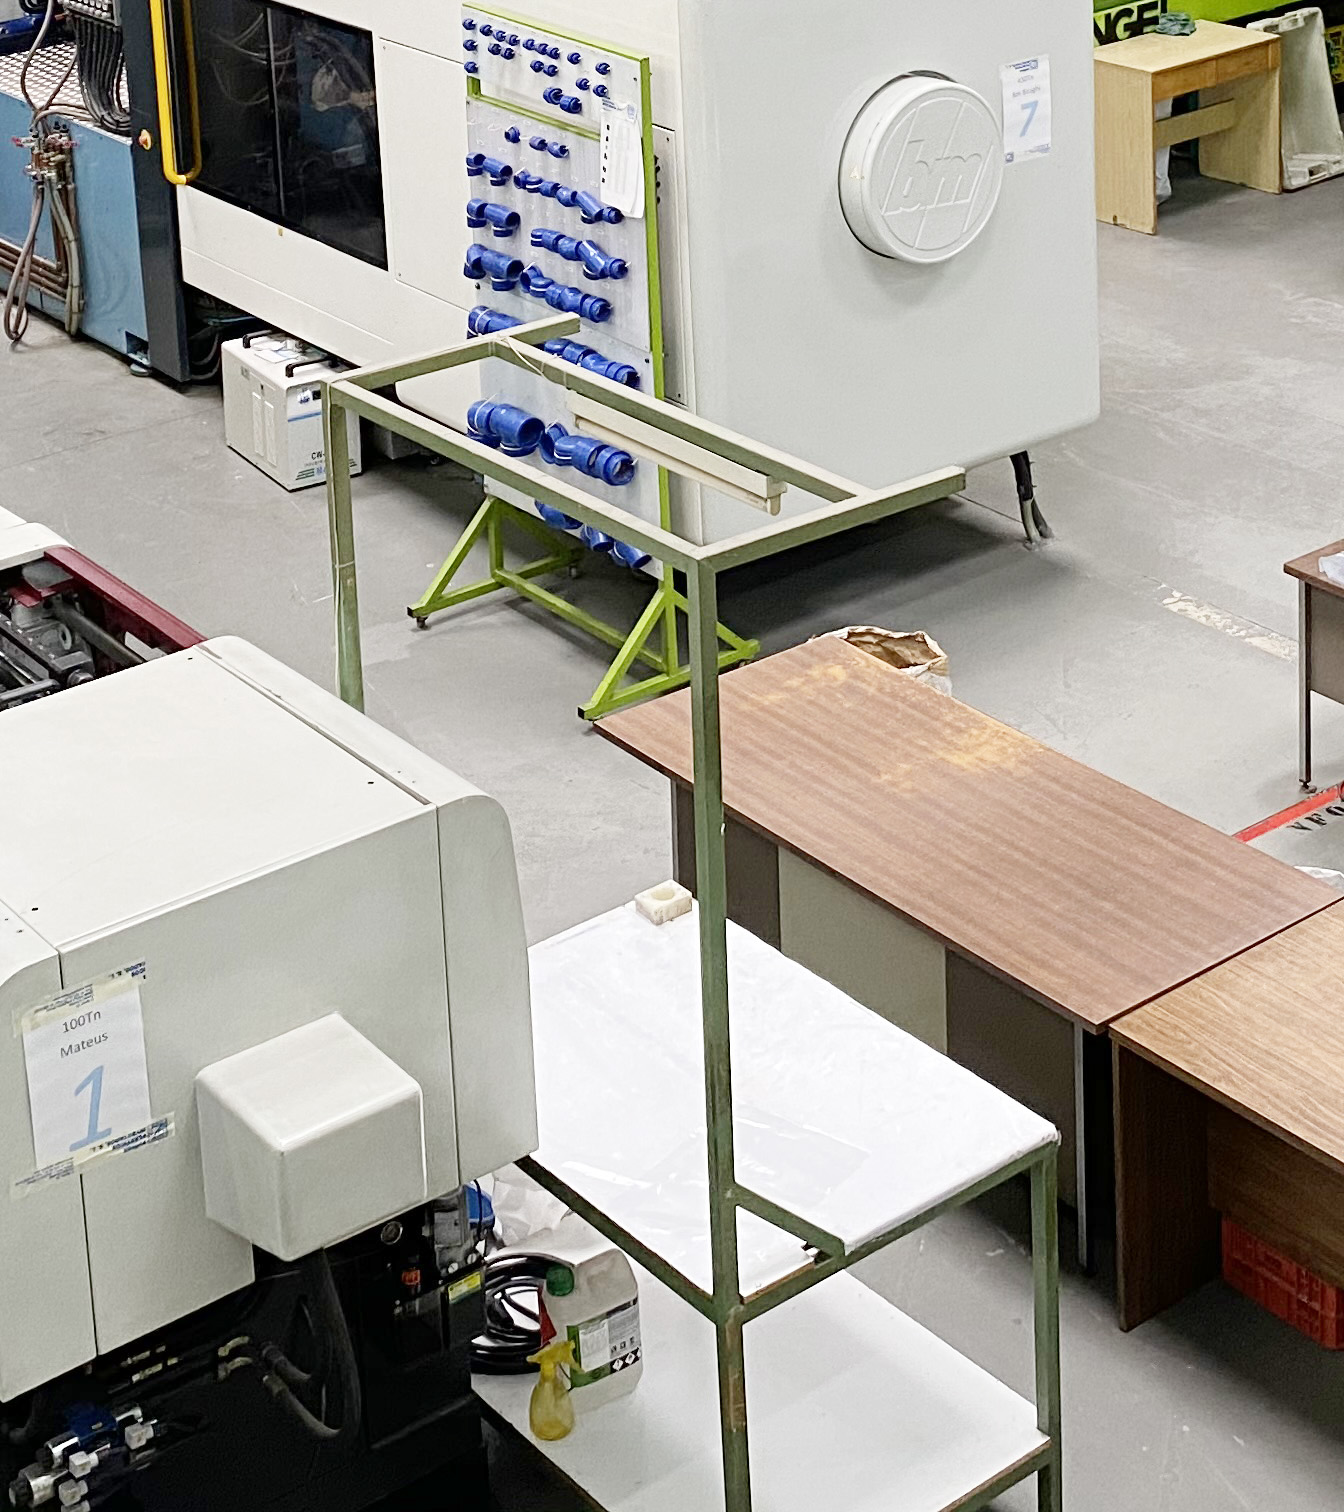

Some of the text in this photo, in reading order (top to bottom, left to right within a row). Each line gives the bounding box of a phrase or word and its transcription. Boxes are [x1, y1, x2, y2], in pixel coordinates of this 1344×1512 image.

[1019, 100, 1039, 138] 7
[61, 1010, 102, 1034] 100Tn
[59, 1031, 109, 1059] Mateus
[69, 1064, 113, 1153] 1
